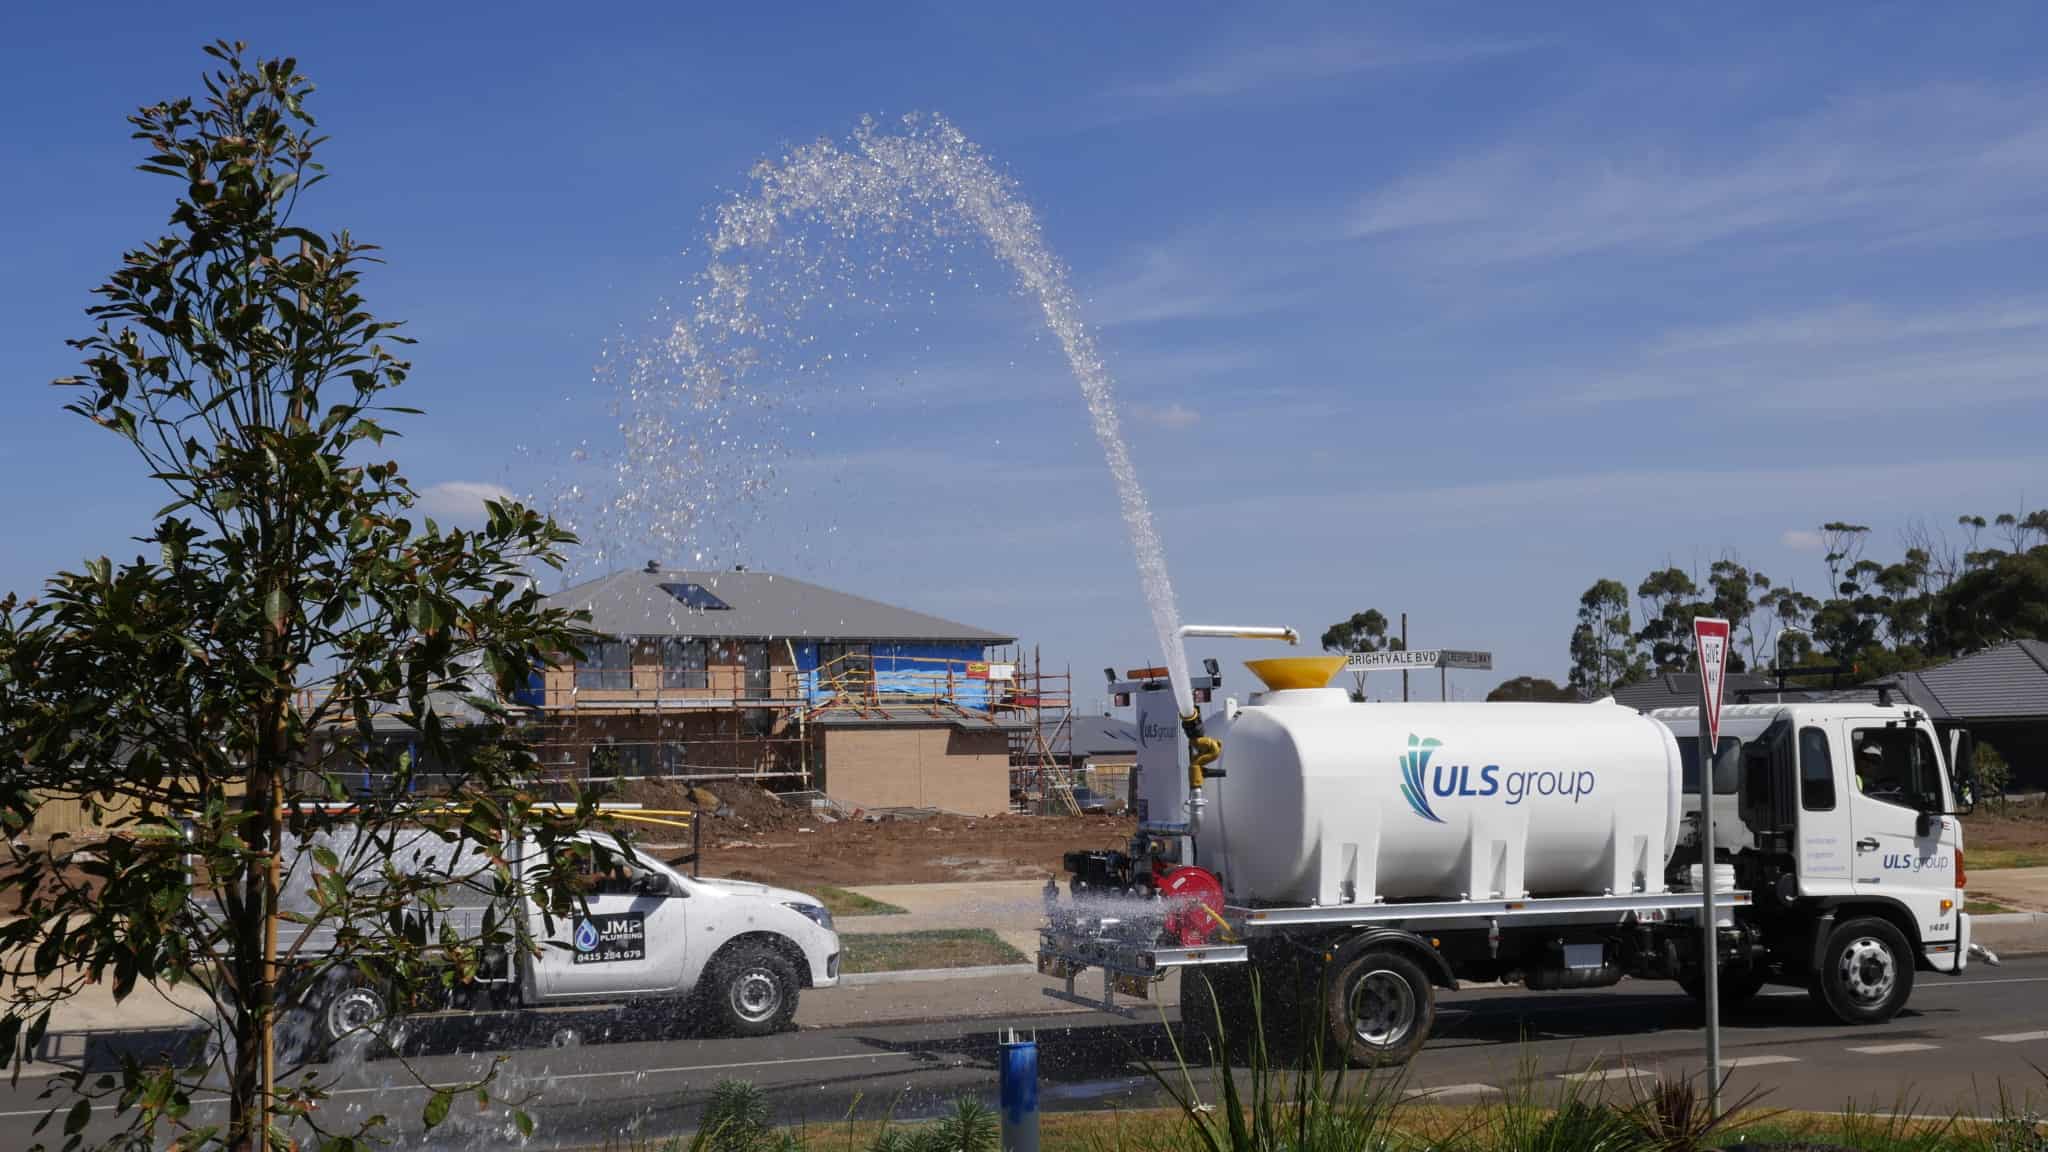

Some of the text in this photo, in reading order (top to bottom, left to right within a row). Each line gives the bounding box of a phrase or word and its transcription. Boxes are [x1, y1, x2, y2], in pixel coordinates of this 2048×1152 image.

[1348, 652, 1413, 666] BRIGHTVALE
[1415, 651, 1437, 664] BVD
[1705, 643, 1720, 664] GIVE
[1433, 765, 1595, 805] ULS group
[1883, 854, 1949, 873] ULS group
[601, 919, 642, 935] JMP
[600, 932, 643, 942] PLUMBING
[577, 952, 601, 962] 0415
[623, 949, 641, 959] 679
